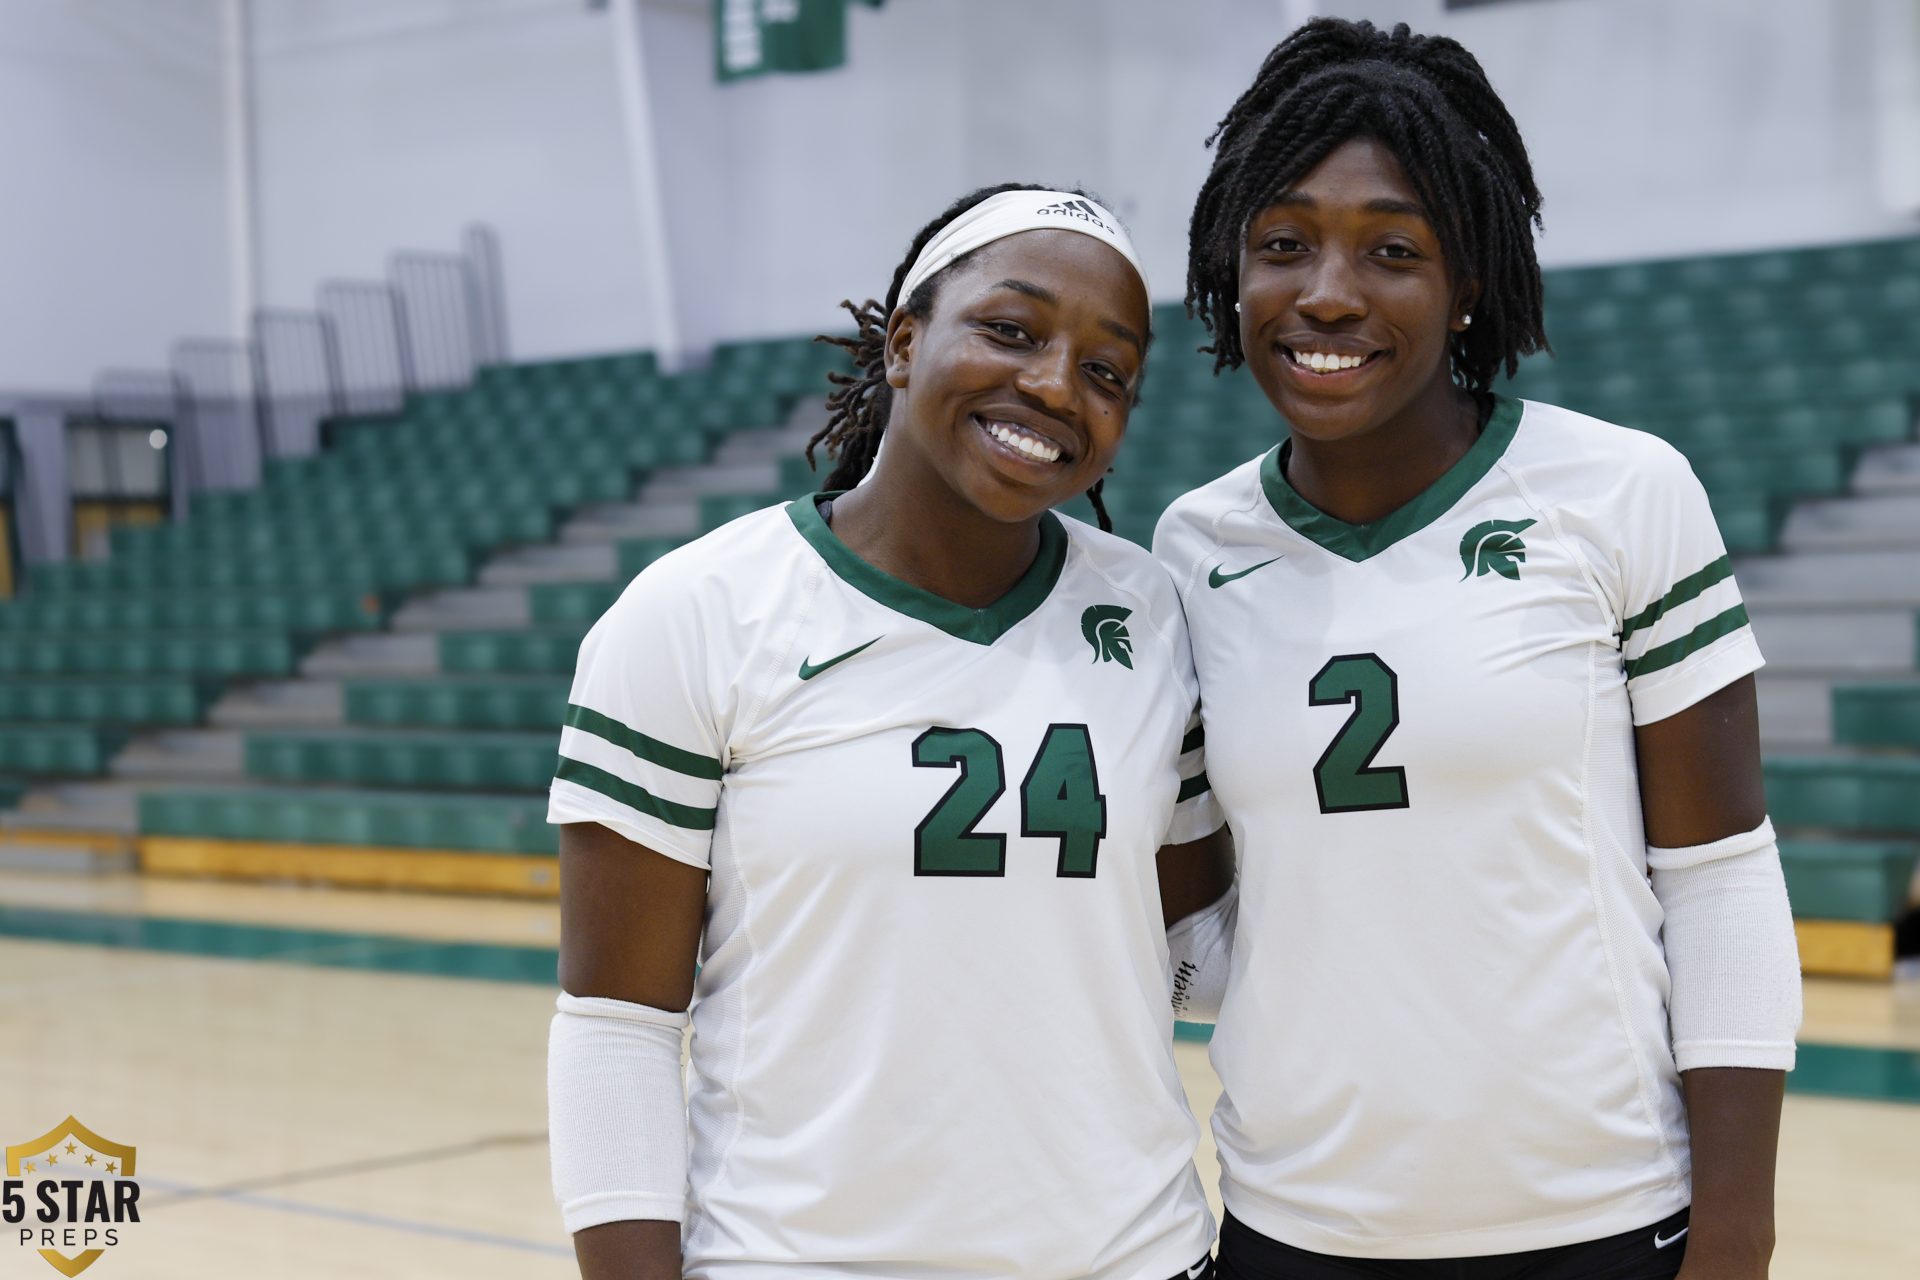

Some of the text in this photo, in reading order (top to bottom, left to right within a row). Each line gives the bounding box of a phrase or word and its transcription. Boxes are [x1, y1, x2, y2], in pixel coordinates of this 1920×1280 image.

[1036, 207, 1115, 235] adidas
[911, 723, 1107, 879] 24
[1308, 652, 1410, 814] 2
